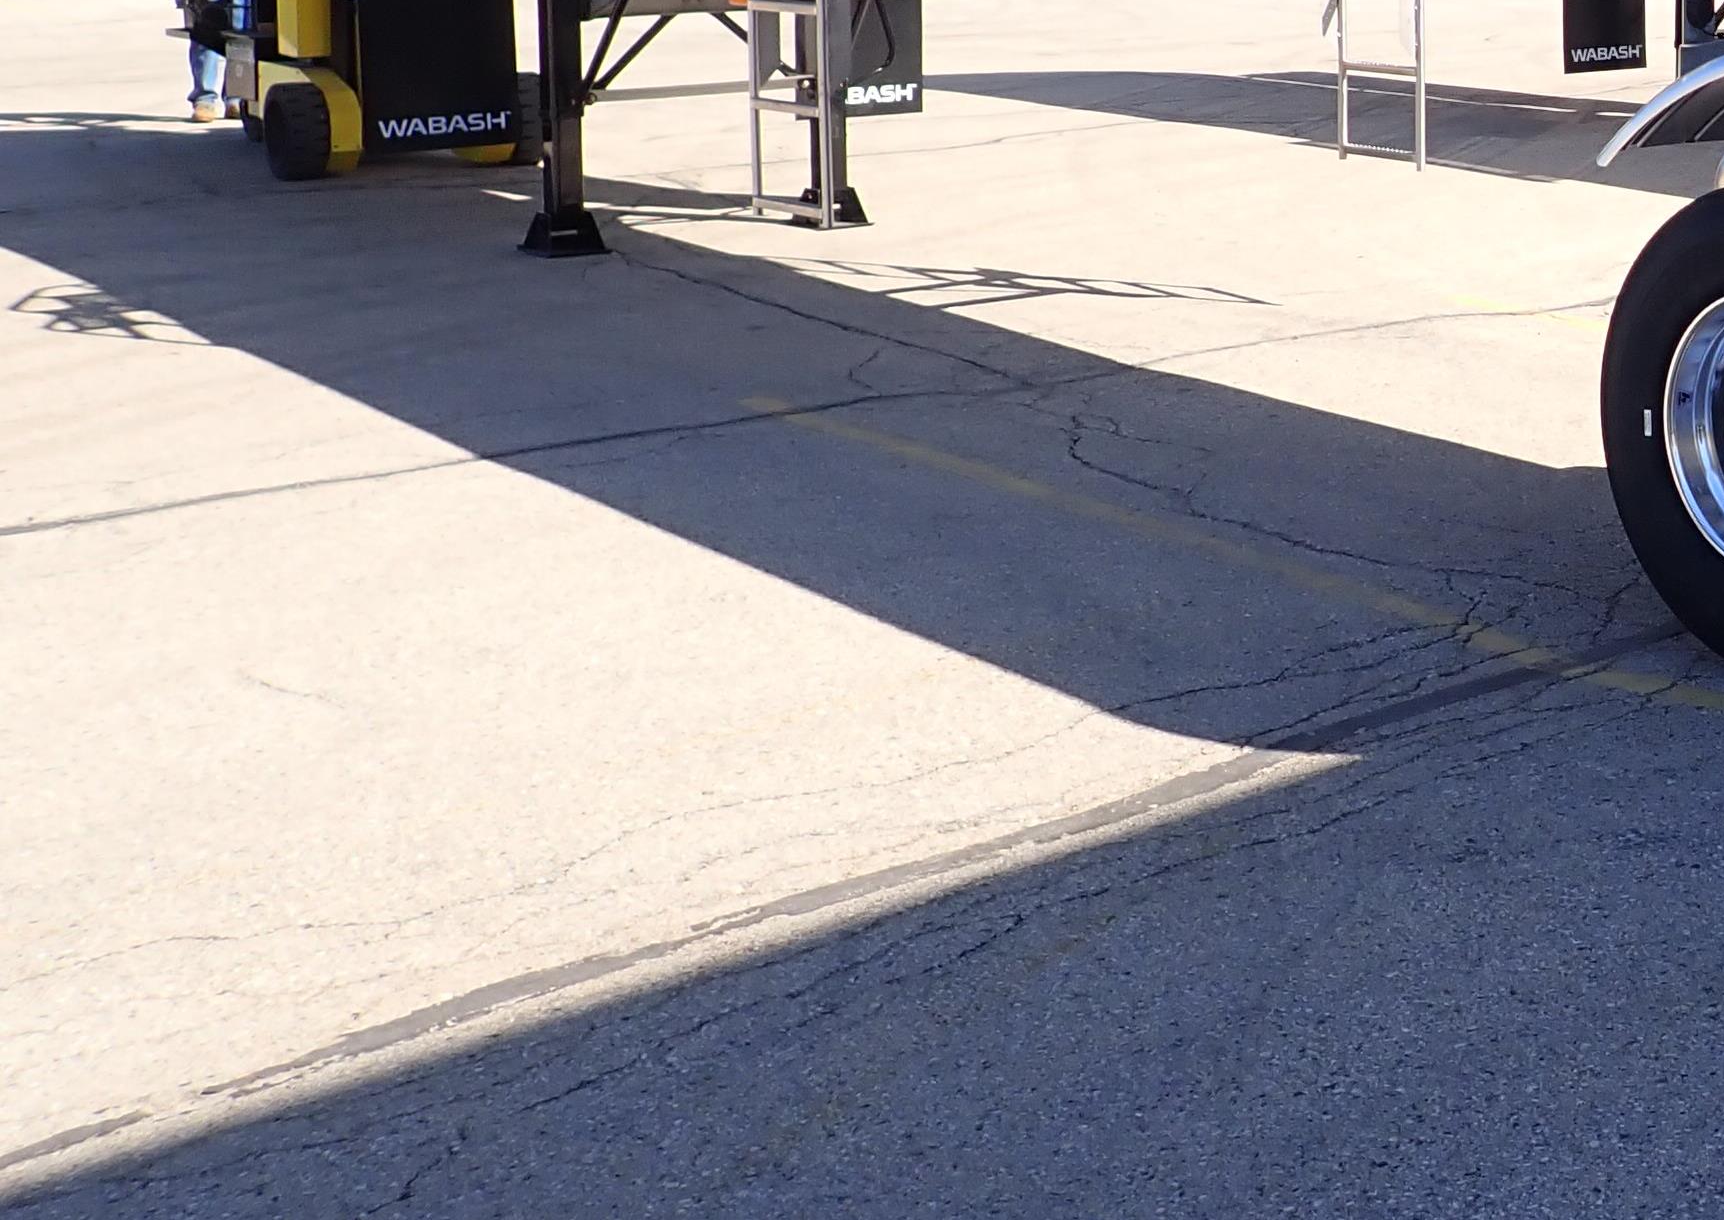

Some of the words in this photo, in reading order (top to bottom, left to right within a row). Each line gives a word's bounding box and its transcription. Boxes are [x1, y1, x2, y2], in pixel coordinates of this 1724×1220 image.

[1571, 45, 1641, 63] WABASH
[845, 84, 914, 105] BASH
[378, 111, 507, 139] WABASH
